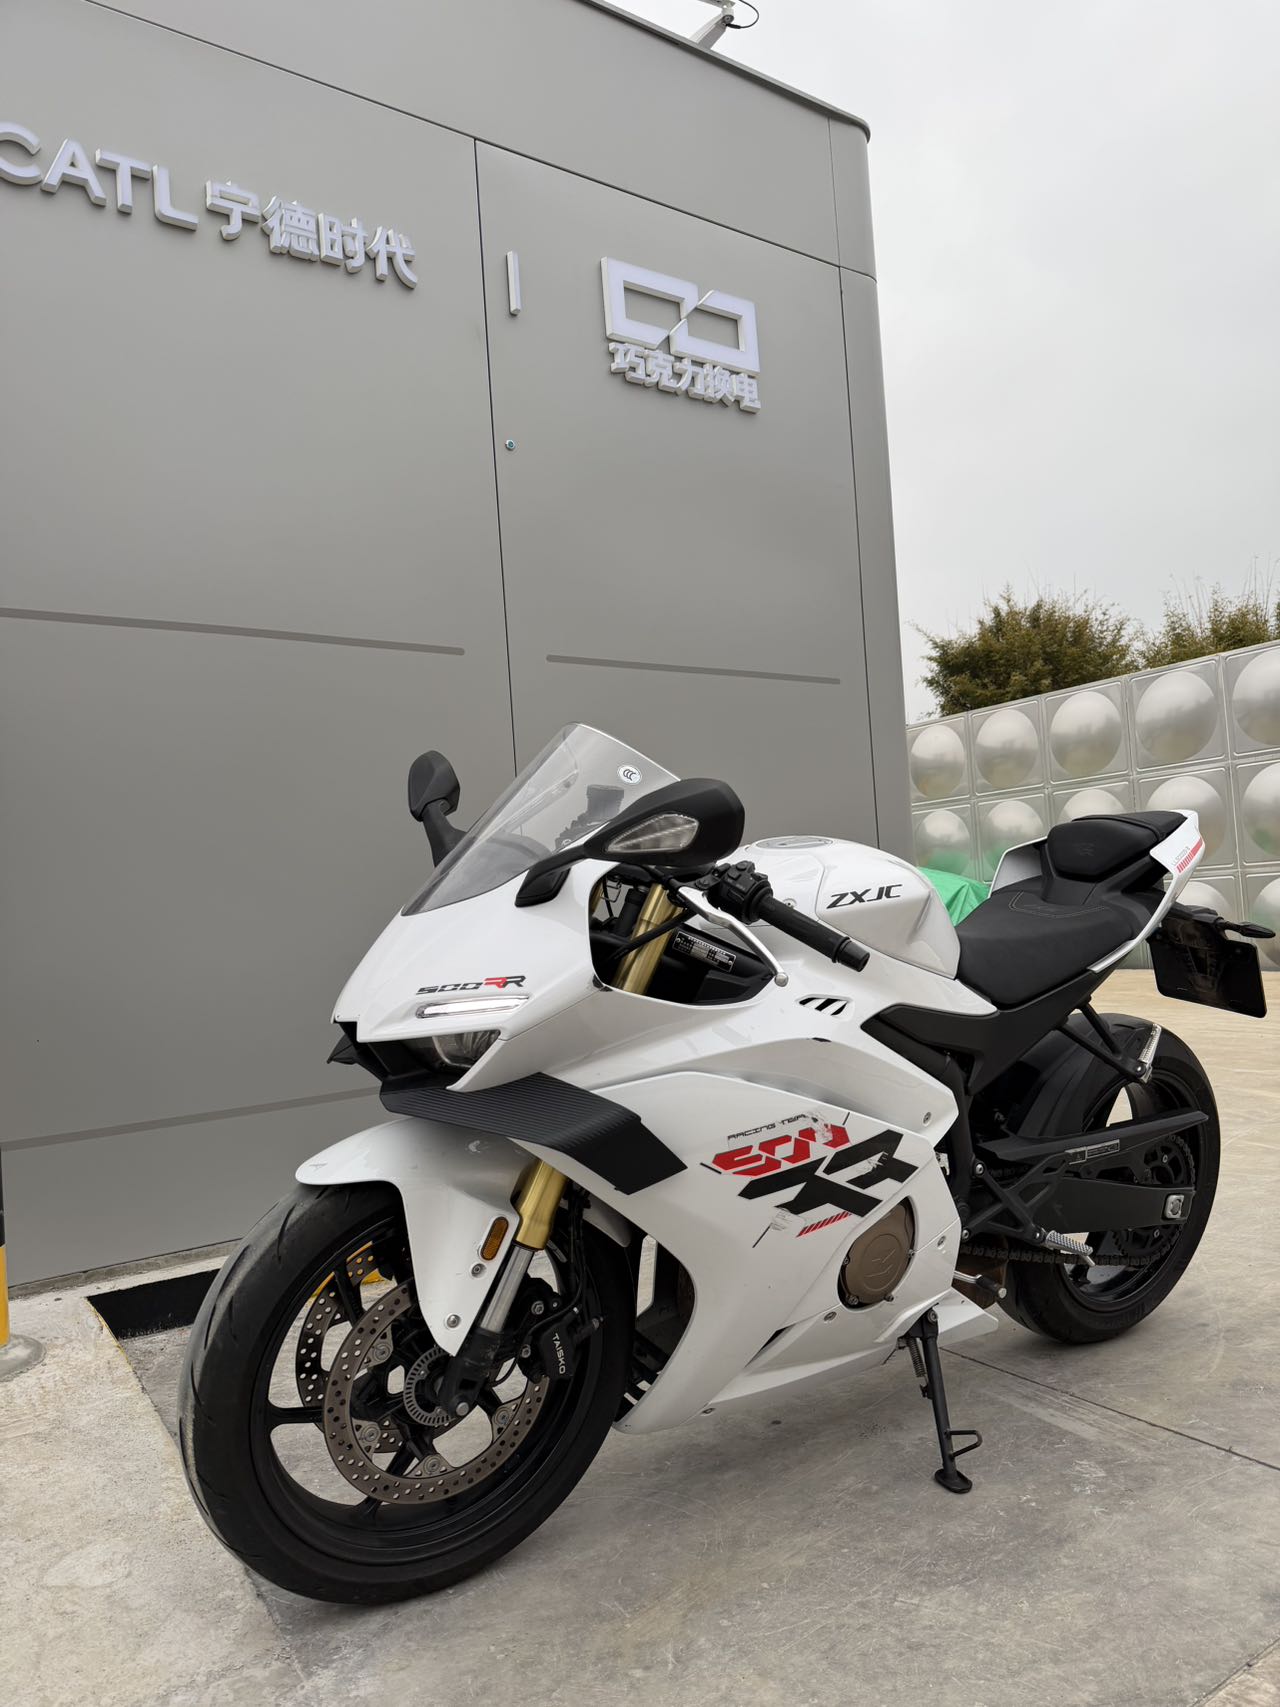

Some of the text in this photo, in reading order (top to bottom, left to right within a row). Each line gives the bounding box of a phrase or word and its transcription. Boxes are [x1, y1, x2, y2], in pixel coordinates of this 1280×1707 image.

[0, 121, 419, 290] CATL 宁德时代
[608, 342, 761, 414] 巧克力换电
[826, 884, 904, 910] ZXJC
[727, 1122, 776, 1140] RACING
[551, 1332, 567, 1375] TAISKO
